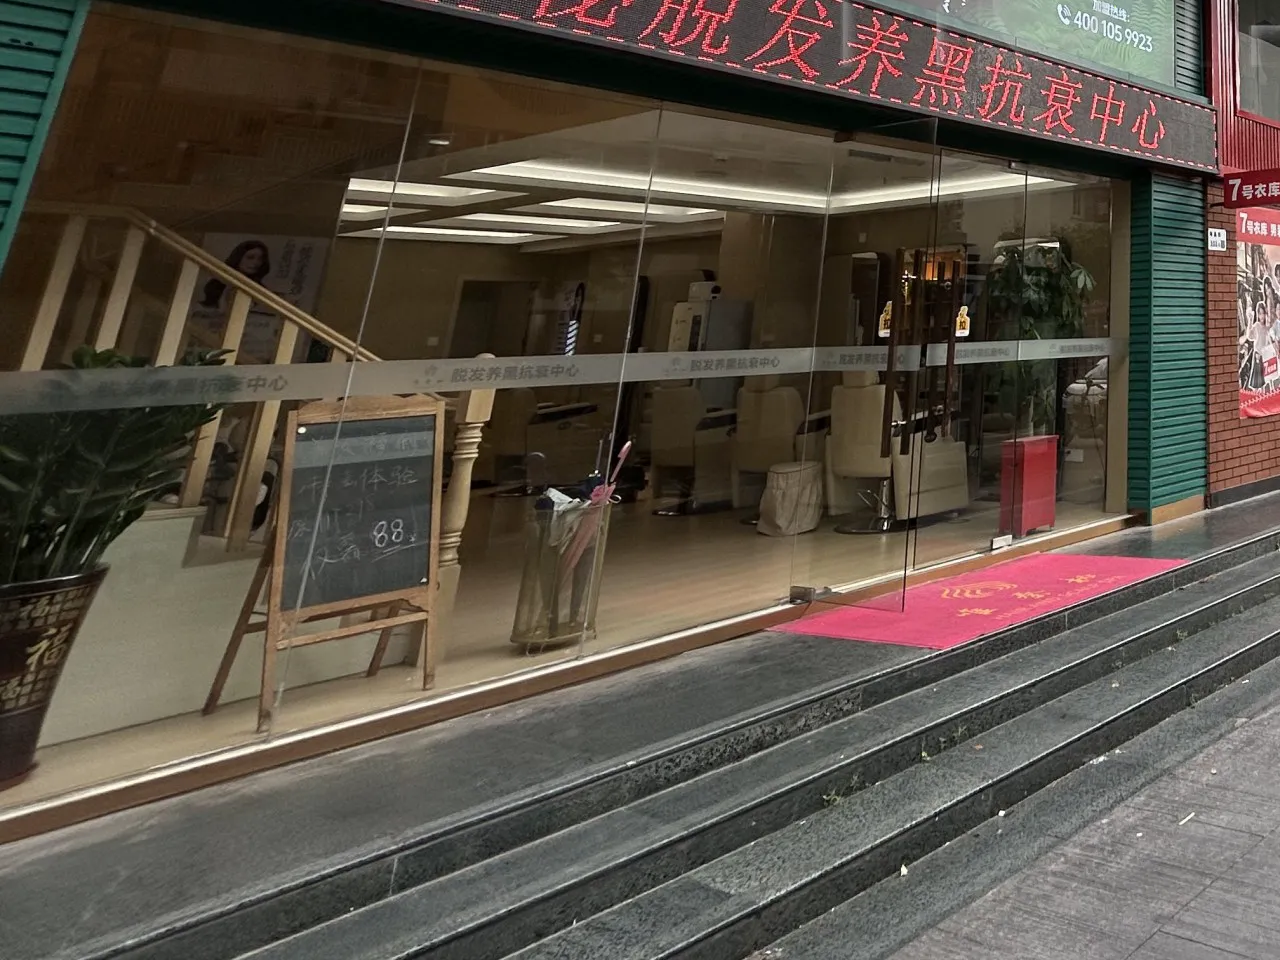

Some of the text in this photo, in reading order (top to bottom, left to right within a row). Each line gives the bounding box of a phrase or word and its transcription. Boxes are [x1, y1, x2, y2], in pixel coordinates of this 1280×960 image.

[1073, 10, 1154, 53] 400 105 9923
[1228, 178, 1280, 202] 7号衣库
